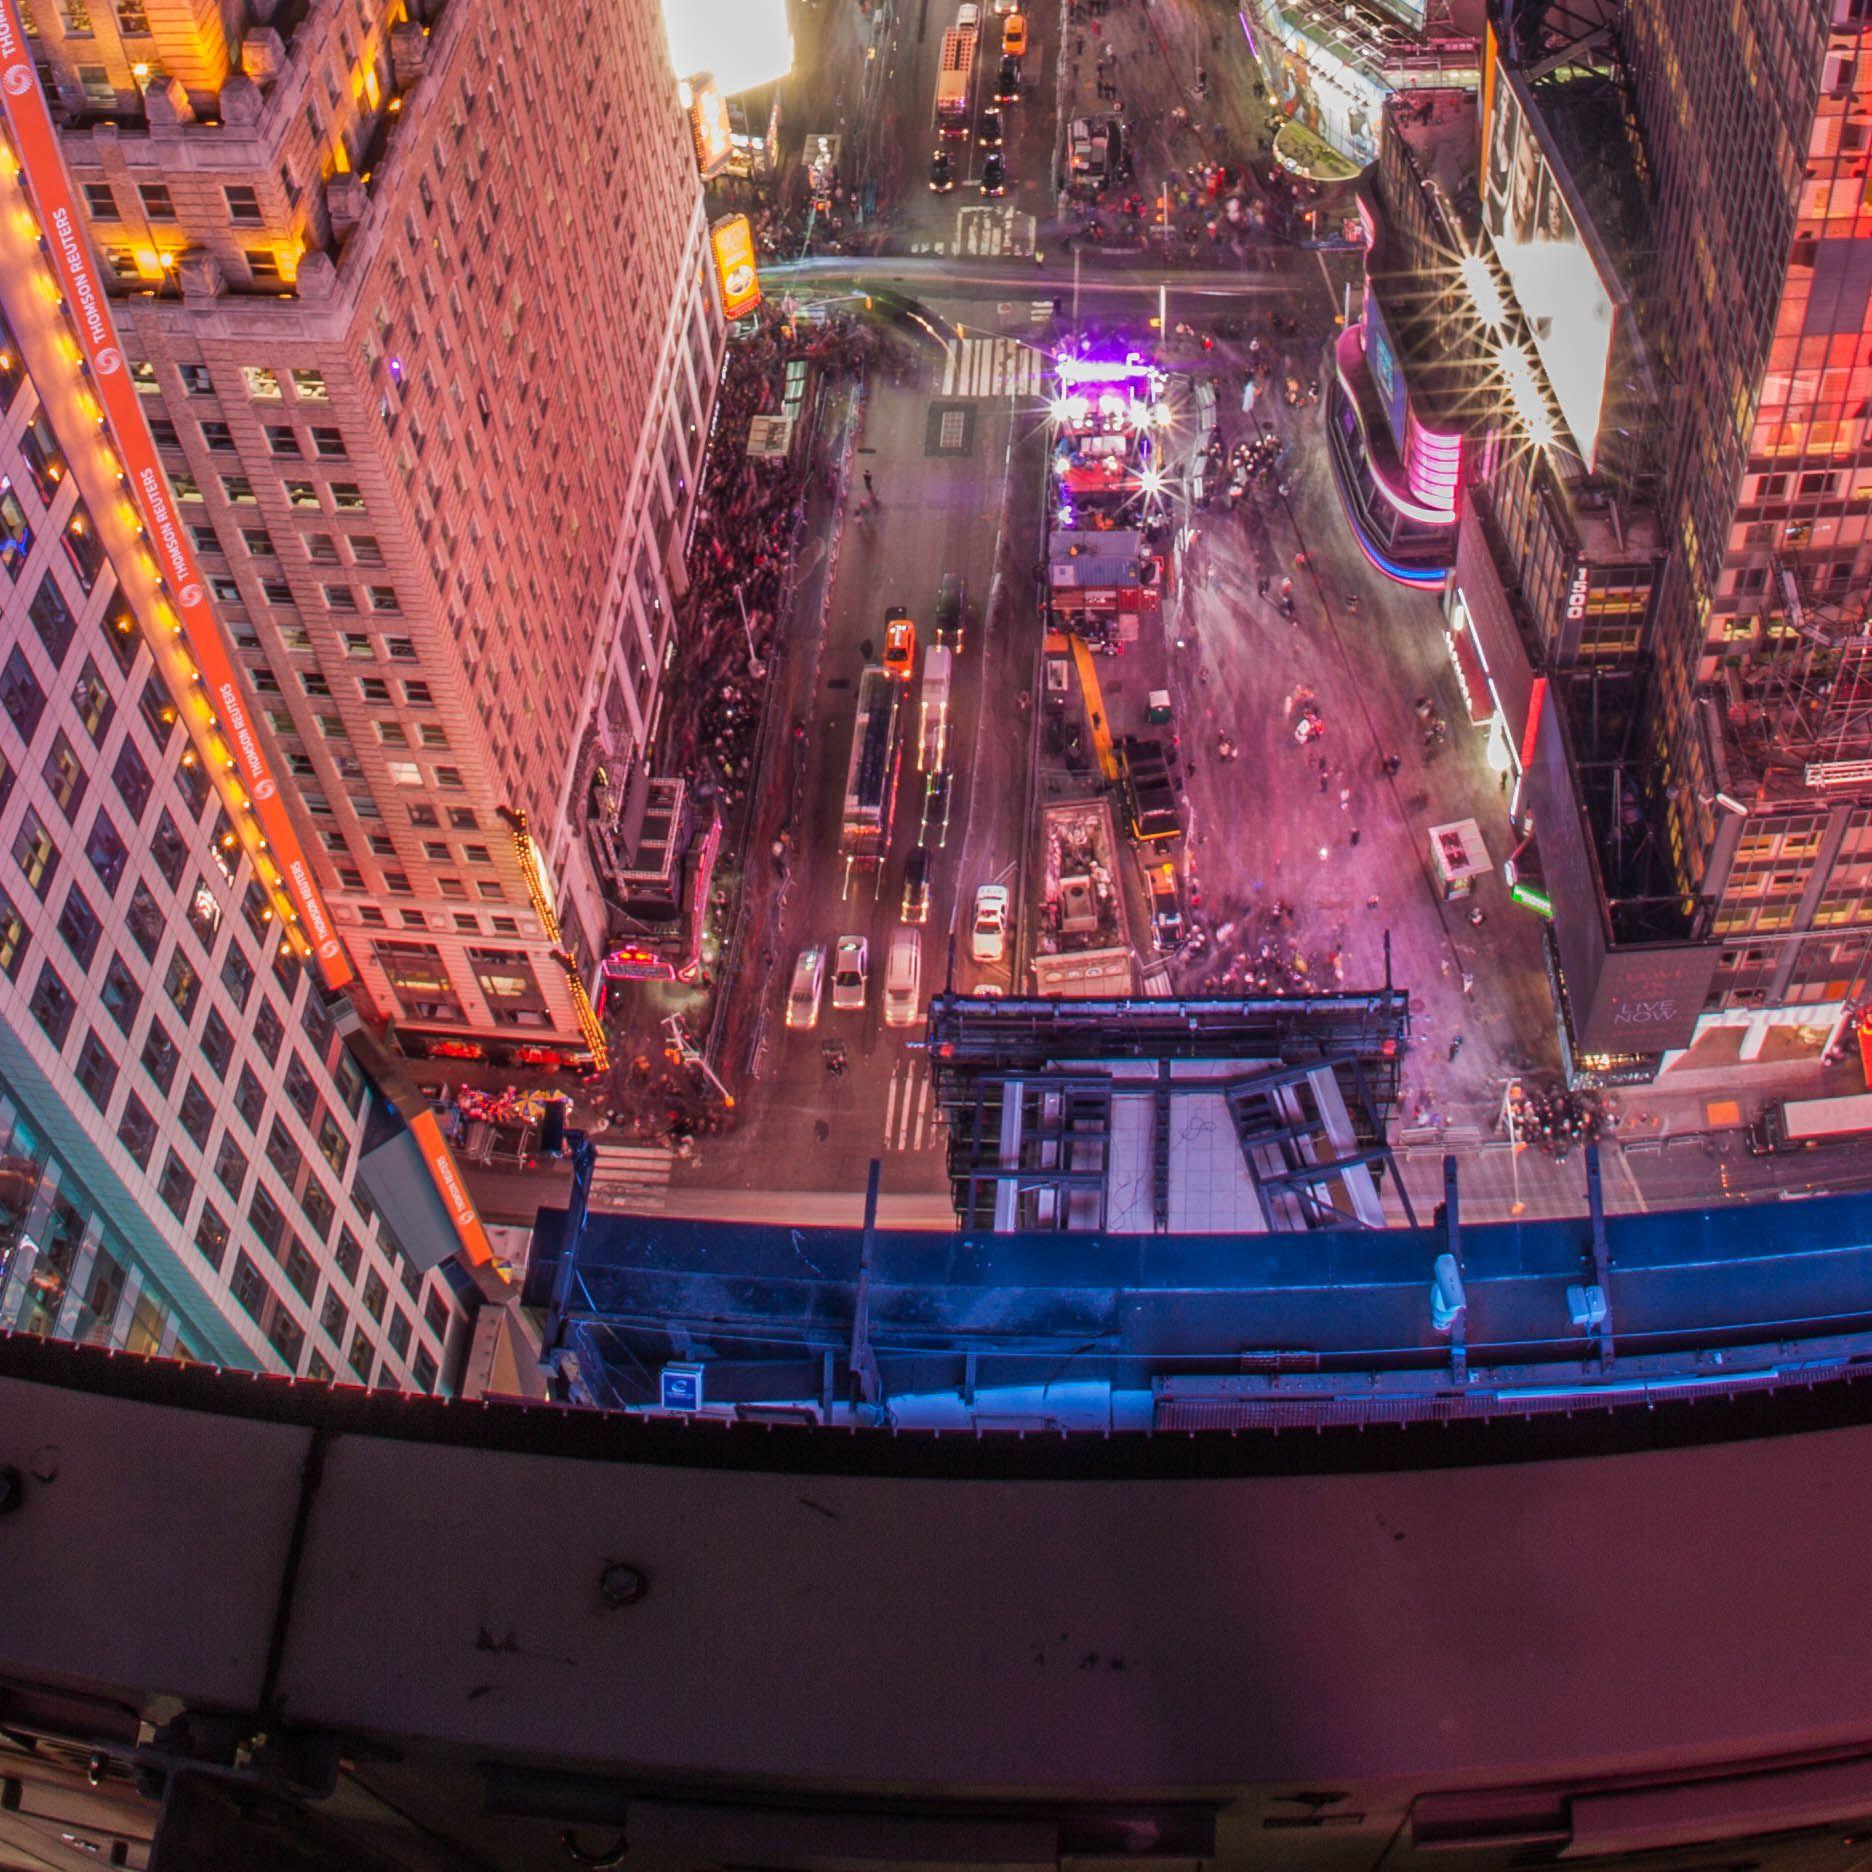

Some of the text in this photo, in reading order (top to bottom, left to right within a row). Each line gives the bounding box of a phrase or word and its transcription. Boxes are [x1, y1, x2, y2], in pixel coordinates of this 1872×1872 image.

[53, 207, 107, 344] THOMSON REUTERS
[140, 467, 189, 582] THOMSON REUTERS
[219, 683, 263, 778] THOMSON REUTERS
[1614, 1009, 1678, 1025] NOW
[1621, 999, 1676, 1014] LIVE
